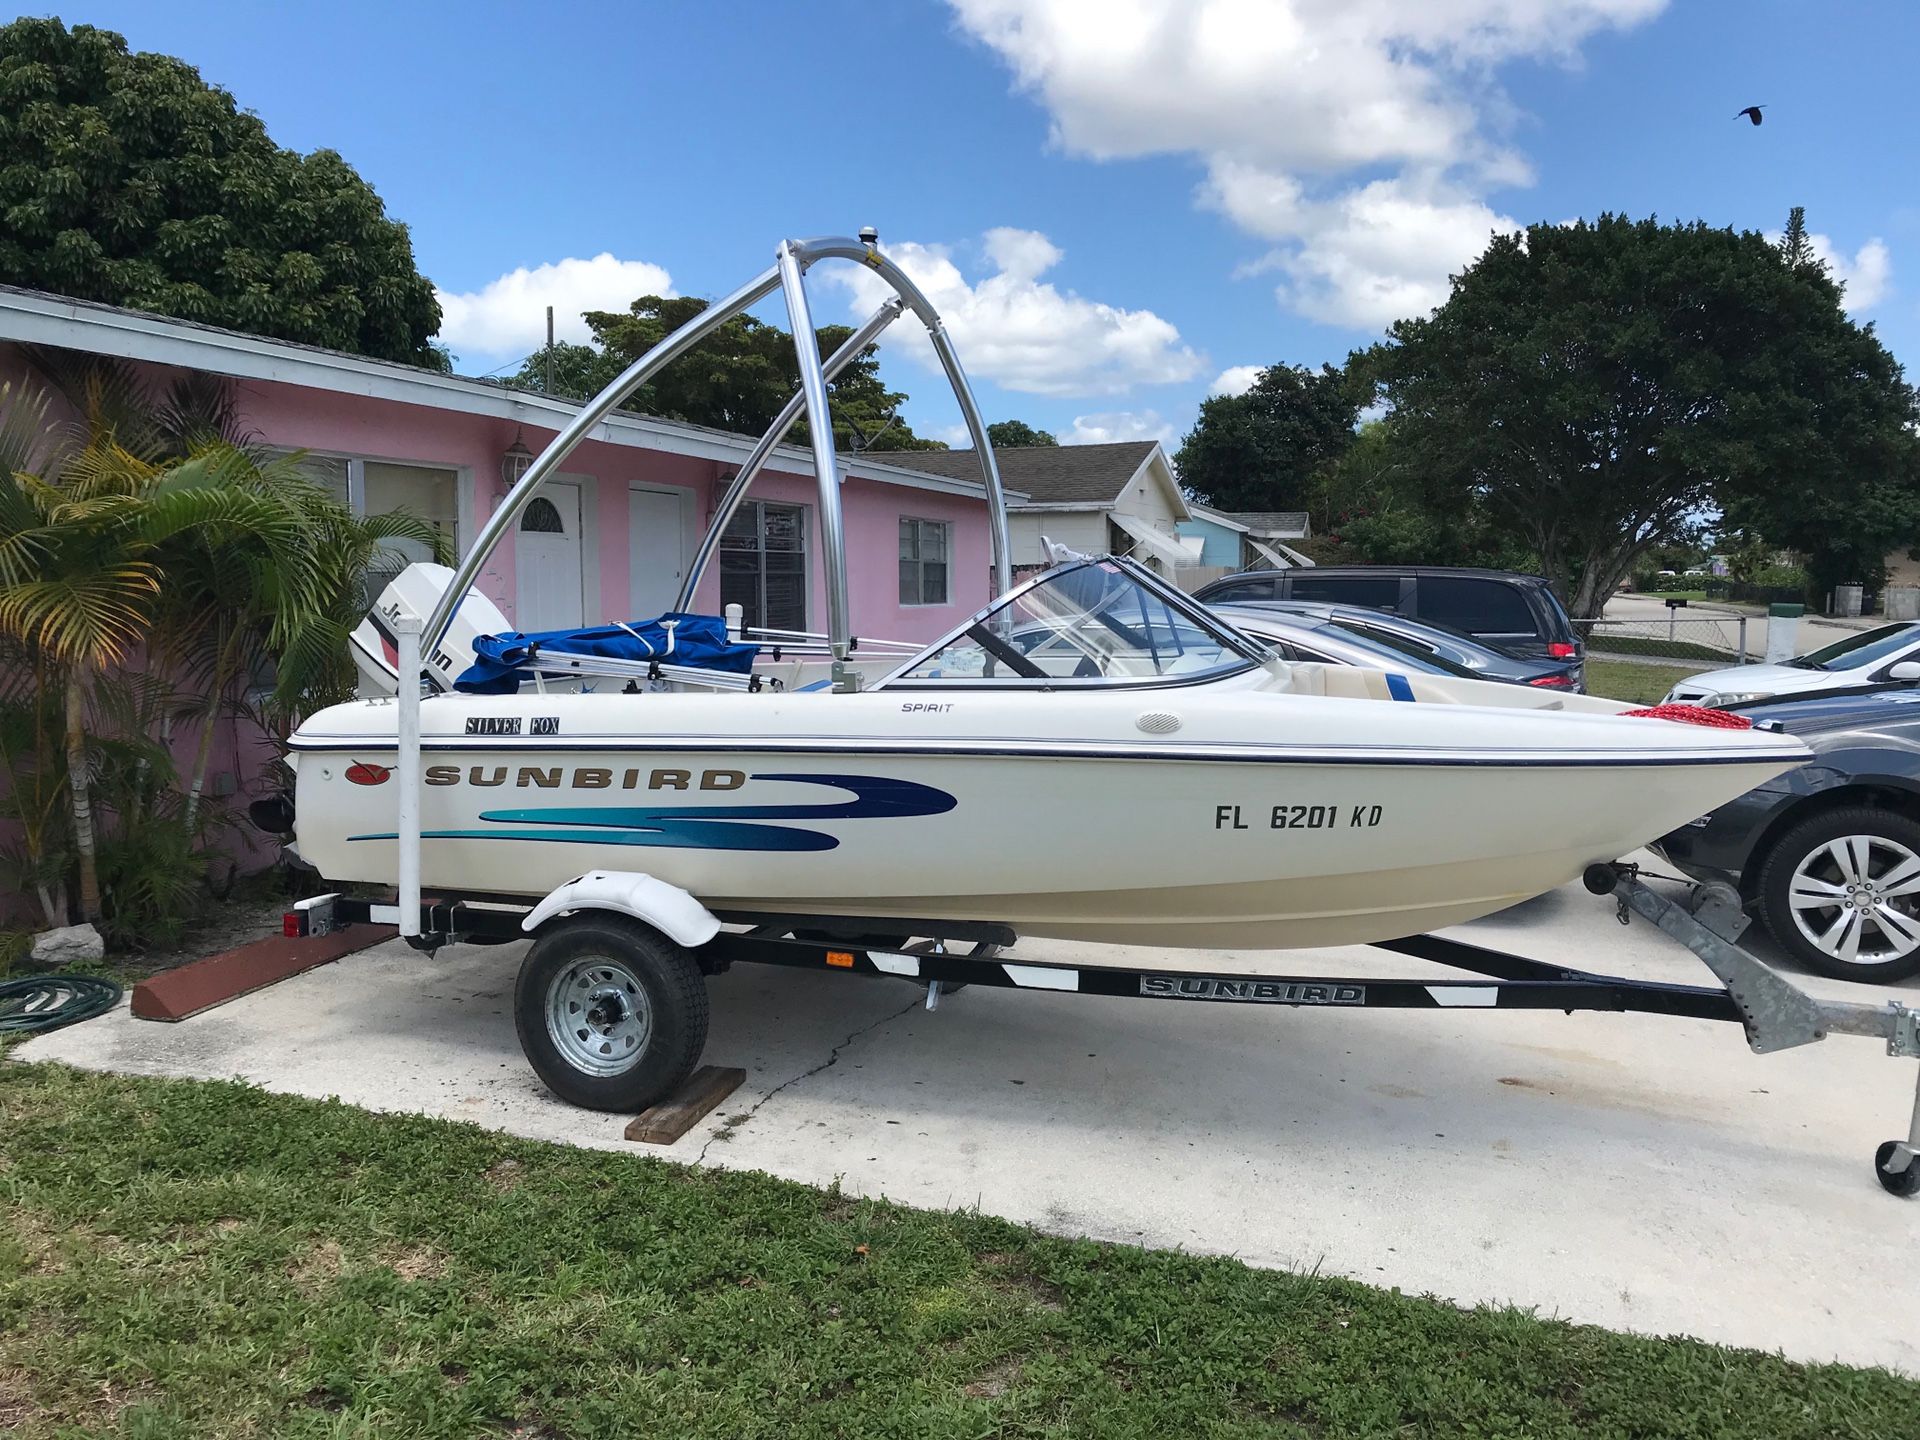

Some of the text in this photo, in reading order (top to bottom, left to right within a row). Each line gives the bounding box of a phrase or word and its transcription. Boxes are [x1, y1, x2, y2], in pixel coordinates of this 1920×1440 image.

[901, 703, 955, 713] SPIRIT
[465, 717, 560, 735] SILVER FOX
[424, 766, 746, 790] SUNBIRD
[1215, 805, 1249, 829] FL
[1270, 805, 1338, 829] 6201
[1143, 976, 1365, 1003] SUNBIRD
